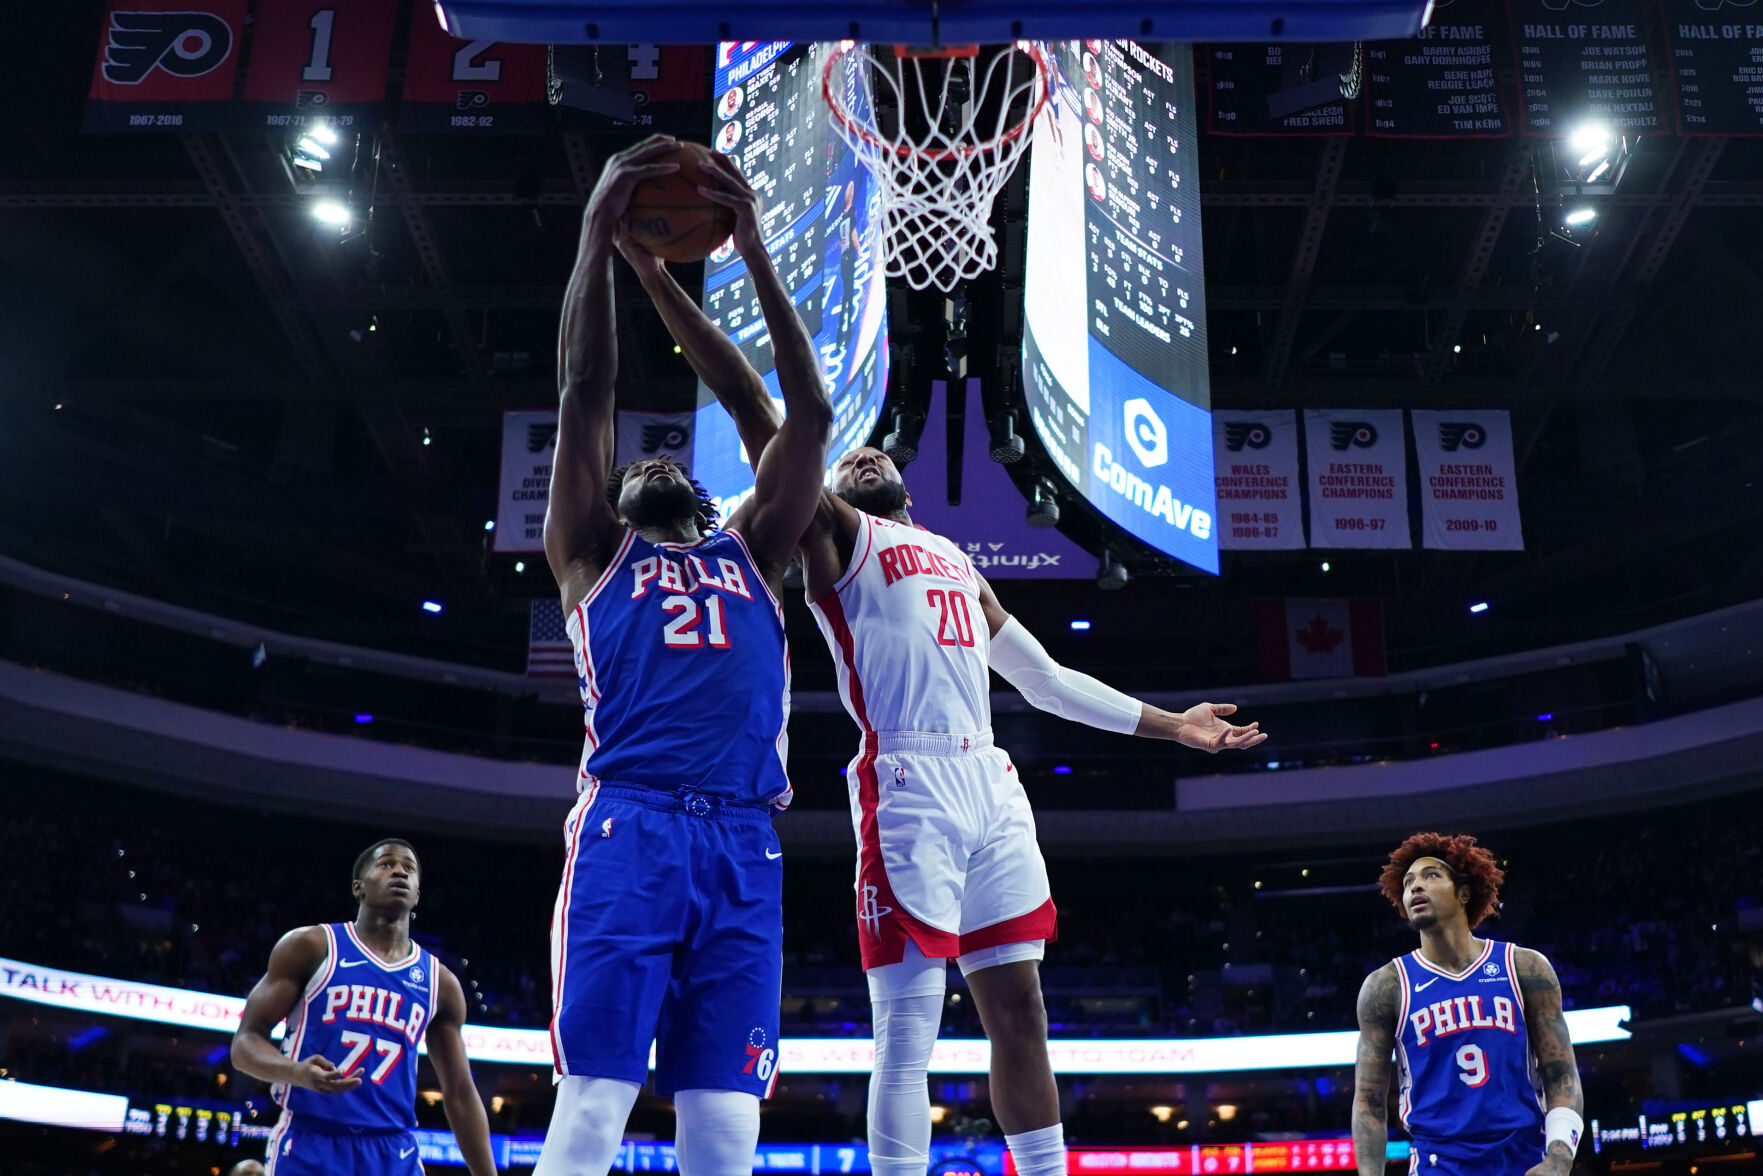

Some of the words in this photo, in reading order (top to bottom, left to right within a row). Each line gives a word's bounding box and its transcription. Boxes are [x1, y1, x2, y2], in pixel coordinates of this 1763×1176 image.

[1440, 25, 1484, 39] FAME
[1523, 24, 1564, 39] HALL
[1567, 24, 1587, 39] OF
[1591, 24, 1636, 39] FAME
[1678, 24, 1719, 39] HALL
[1722, 24, 1742, 39] OF
[1745, 24, 1763, 39] FA
[302, 9, 335, 81] 1
[1423, 46, 1455, 56] BARRY
[1582, 46, 1601, 56] JOE
[1602, 45, 1647, 55] WATSON
[1129, 40, 1174, 84] ROCKETS
[1404, 56, 1430, 65] GARY
[1581, 61, 1613, 70] BRIAN
[1444, 71, 1469, 80] GENE
[1588, 75, 1619, 84] MARK
[1621, 73, 1651, 84] HOWE
[1428, 80, 1463, 89] REGGIE
[1588, 89, 1614, 98] DAVE
[1616, 88, 1652, 98] POULIN
[1448, 95, 1467, 105] JOE
[1437, 105, 1450, 114] ED
[1452, 105, 1473, 114] VAN
[129, 114, 183, 126] 1967-2016
[1453, 120, 1473, 129] TIM
[769, 228, 795, 253] STATS
[1137, 246, 1164, 271] STATS
[709, 289, 725, 303] AST
[1231, 465, 1271, 476] WALES
[1330, 463, 1383, 475] EASTERN
[1440, 464, 1493, 475] EASTERN
[1215, 476, 1289, 488] CONFERENCE
[1319, 475, 1396, 487] CONFERENCE
[1429, 476, 1506, 488] CONFERENCE
[1093, 442, 1212, 540] ComAve
[1217, 488, 1288, 500] CHAMPIONS
[1322, 487, 1394, 499] CHAMPIONS
[1433, 488, 1504, 500] CHAMPIONS
[1335, 518, 1386, 531] 1996-97
[1446, 519, 1497, 531] 2009-10
[878, 543, 973, 589] ROCKET
[631, 554, 753, 600] PHILA
[661, 594, 731, 649] 21
[927, 589, 975, 648] 20
[1478, 975, 1509, 983] crypto.com
[1, 966, 79, 998] TALK
[91, 984, 174, 1012] WITH
[182, 1001, 245, 1020] JOH
[322, 984, 427, 1046] PHILA
[1409, 995, 1517, 1048] PHILA
[341, 1030, 404, 1085] 77
[742, 1042, 775, 1081] 76
[1069, 1048, 1102, 1063] TO
[1109, 1048, 1195, 1063] 10AM
[1455, 1043, 1490, 1088] 9
